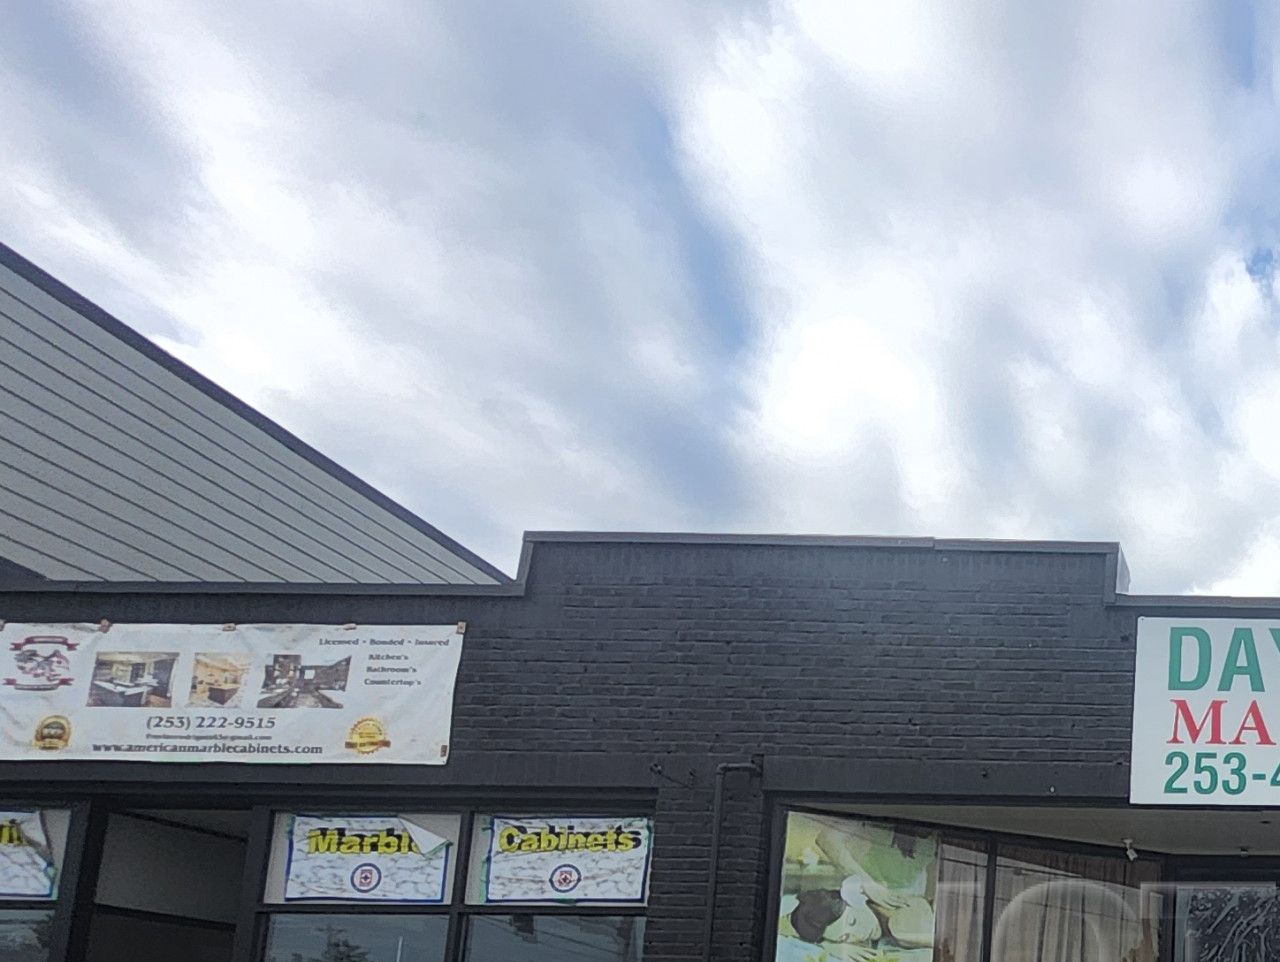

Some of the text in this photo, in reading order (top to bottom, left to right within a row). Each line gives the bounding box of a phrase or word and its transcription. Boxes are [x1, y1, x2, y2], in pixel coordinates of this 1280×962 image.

[319, 638, 359, 646] Licensed
[146, 715, 276, 730] (253) 222-9515
[92, 742, 323, 755] www.americanmarblecabinets.com
[308, 827, 423, 855] Marbl
[500, 825, 641, 852] Cabinets
